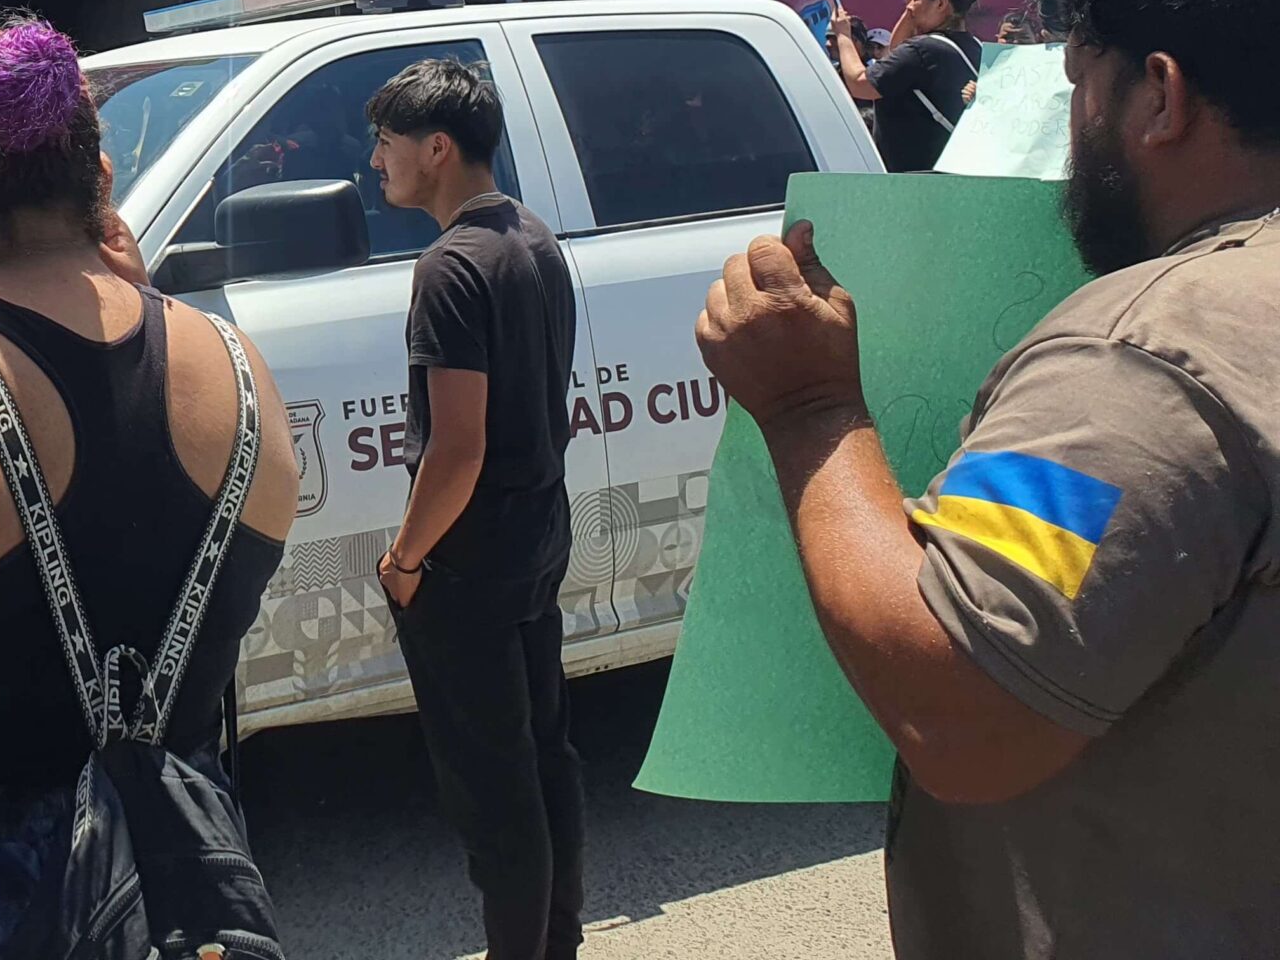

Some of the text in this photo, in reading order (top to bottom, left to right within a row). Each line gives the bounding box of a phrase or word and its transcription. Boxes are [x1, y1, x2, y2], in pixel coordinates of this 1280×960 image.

[597, 363, 629, 385] DE
[221, 427, 255, 520] KIPLING
[29, 502, 71, 607] KIPLING
[161, 582, 206, 676] KIPLING
